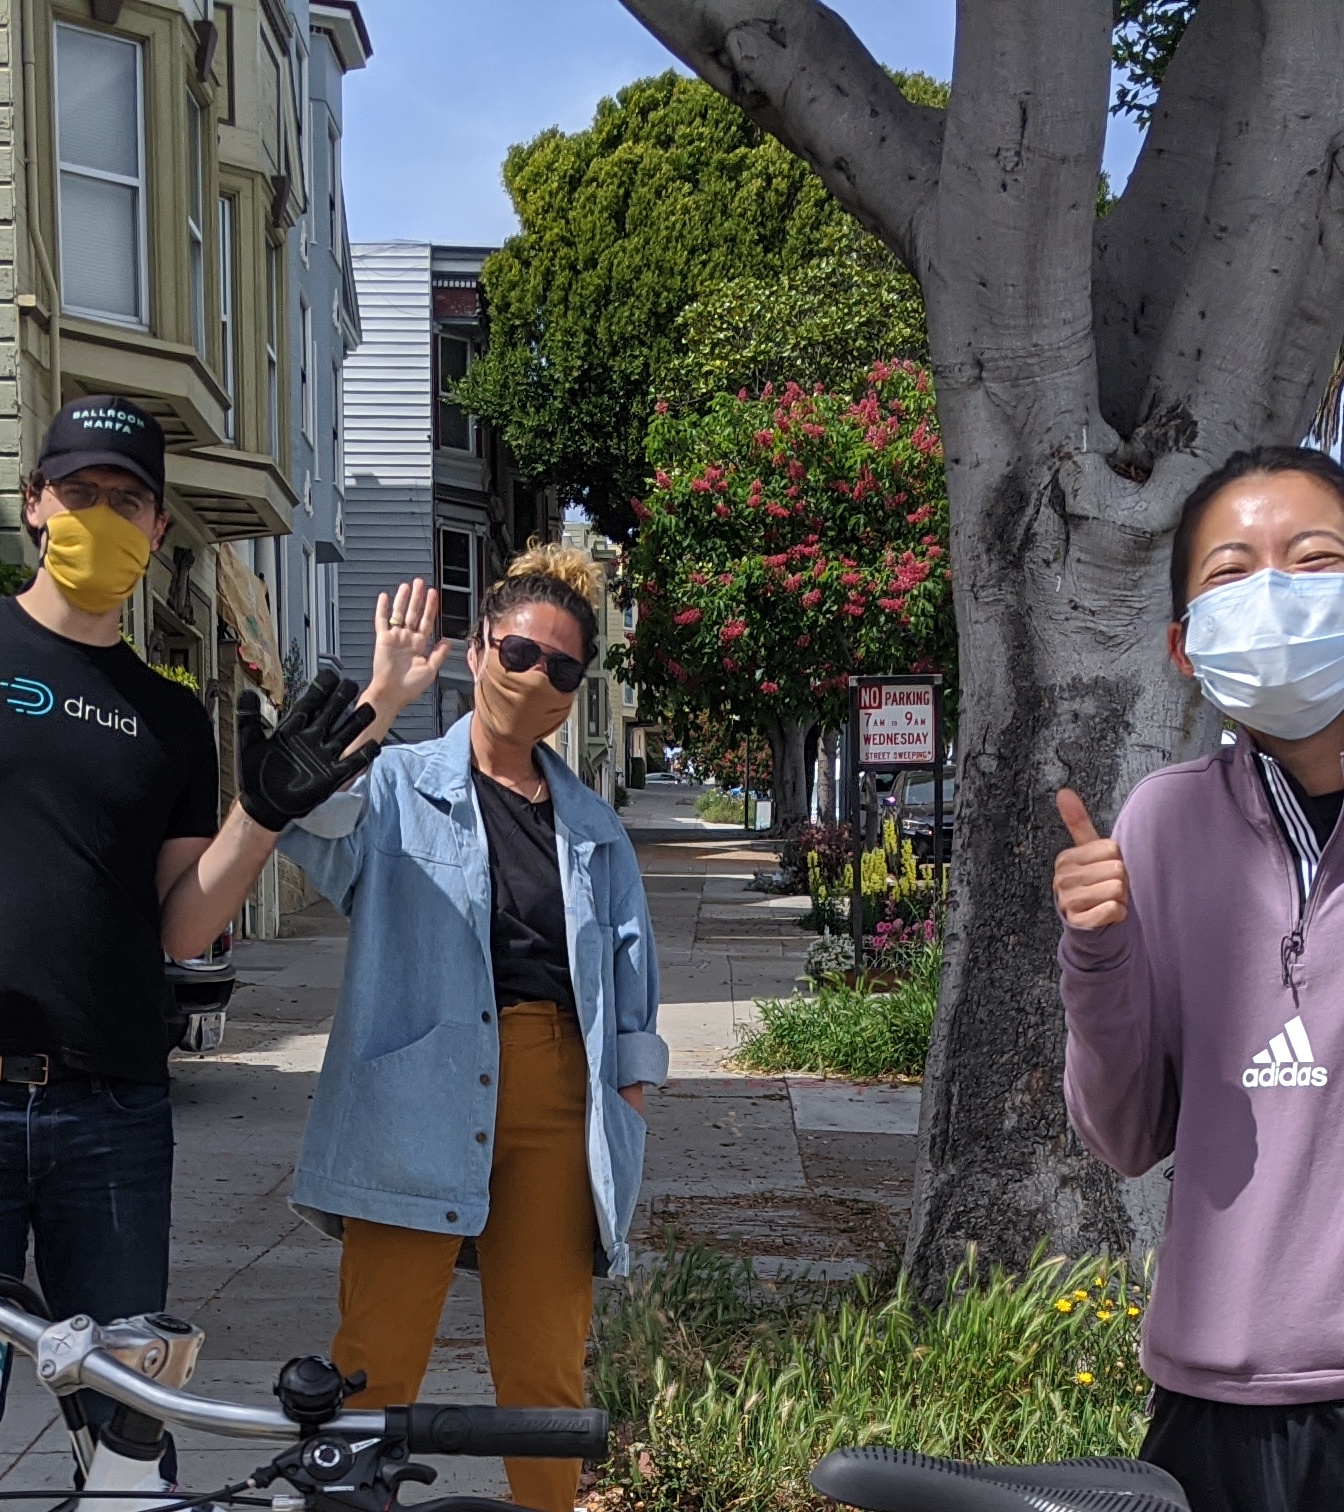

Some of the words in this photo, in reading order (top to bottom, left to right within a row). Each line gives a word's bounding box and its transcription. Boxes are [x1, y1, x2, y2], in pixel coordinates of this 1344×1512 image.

[72, 408, 145, 428] BALLROOM
[83, 420, 131, 434] MARFA
[861, 687, 880, 707] NO
[885, 691, 929, 706] PARKING
[64, 696, 138, 738] druid
[863, 732, 928, 745] WEDNESDAY
[865, 752, 890, 760] STREET
[1242, 1061, 1328, 1088] adidas
